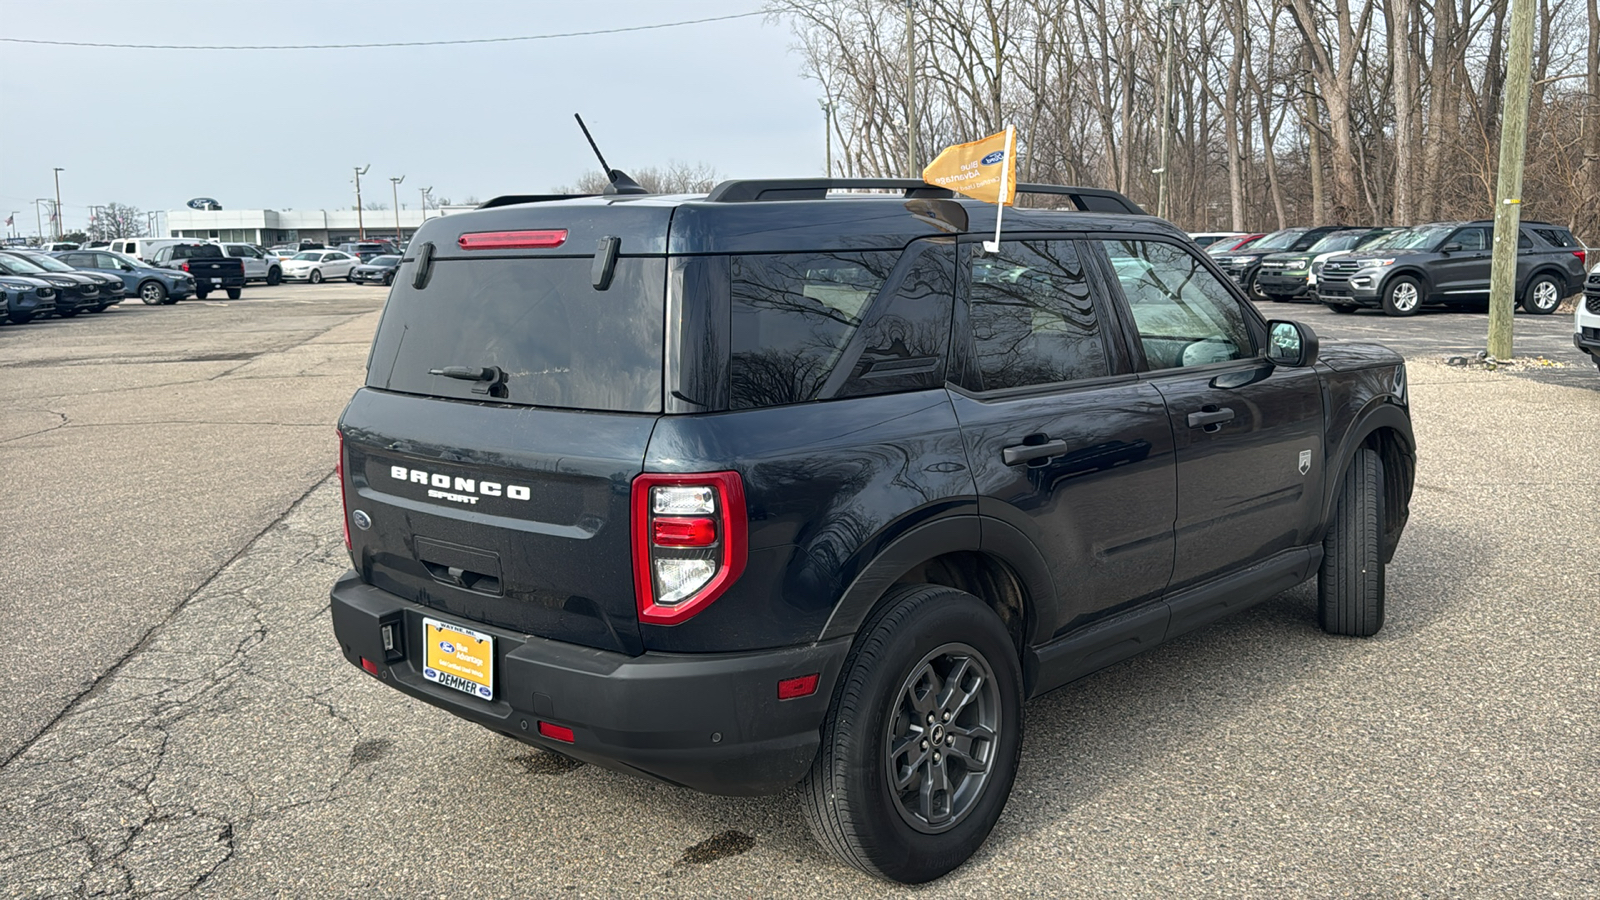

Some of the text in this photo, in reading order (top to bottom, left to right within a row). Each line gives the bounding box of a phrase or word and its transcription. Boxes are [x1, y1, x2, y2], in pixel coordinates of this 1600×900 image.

[390, 466, 530, 501] BRONCO
[428, 490, 480, 504] SPORT
[456, 642, 468, 653] Blue
[438, 672, 477, 694] DEMMER
